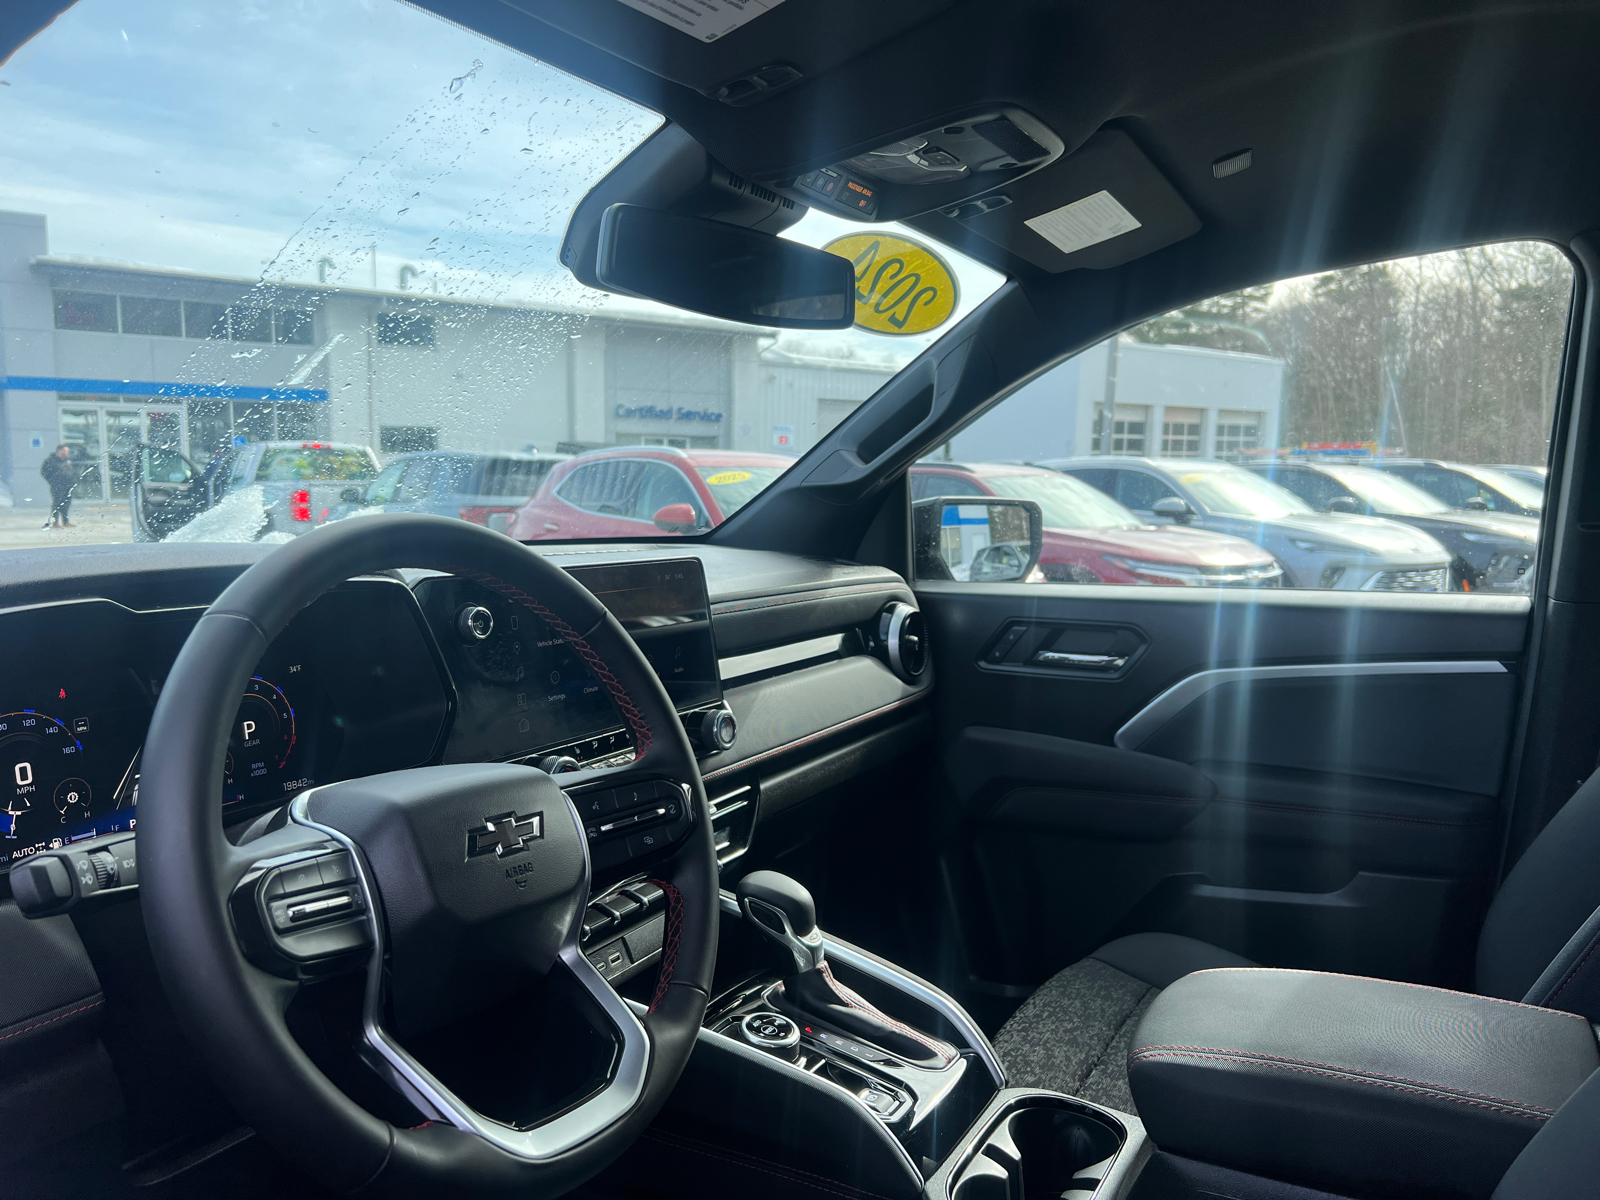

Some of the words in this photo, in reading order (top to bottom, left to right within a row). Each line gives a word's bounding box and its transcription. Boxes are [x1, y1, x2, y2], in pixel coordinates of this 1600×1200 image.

[615, 404, 673, 419] Certified
[677, 406, 724, 423] Service
[22, 718, 36, 727] 120
[45, 726, 59, 734] 140
[243, 720, 256, 740] P
[244, 739, 261, 748] GEAR
[62, 746, 76, 754] 160
[251, 762, 265, 770] RPM
[14, 762, 33, 785] 0
[16, 785, 36, 795] MPH
[60, 816, 66, 824] C
[12, 846, 36, 859] AUTO
[505, 862, 533, 880] AIRBAG
